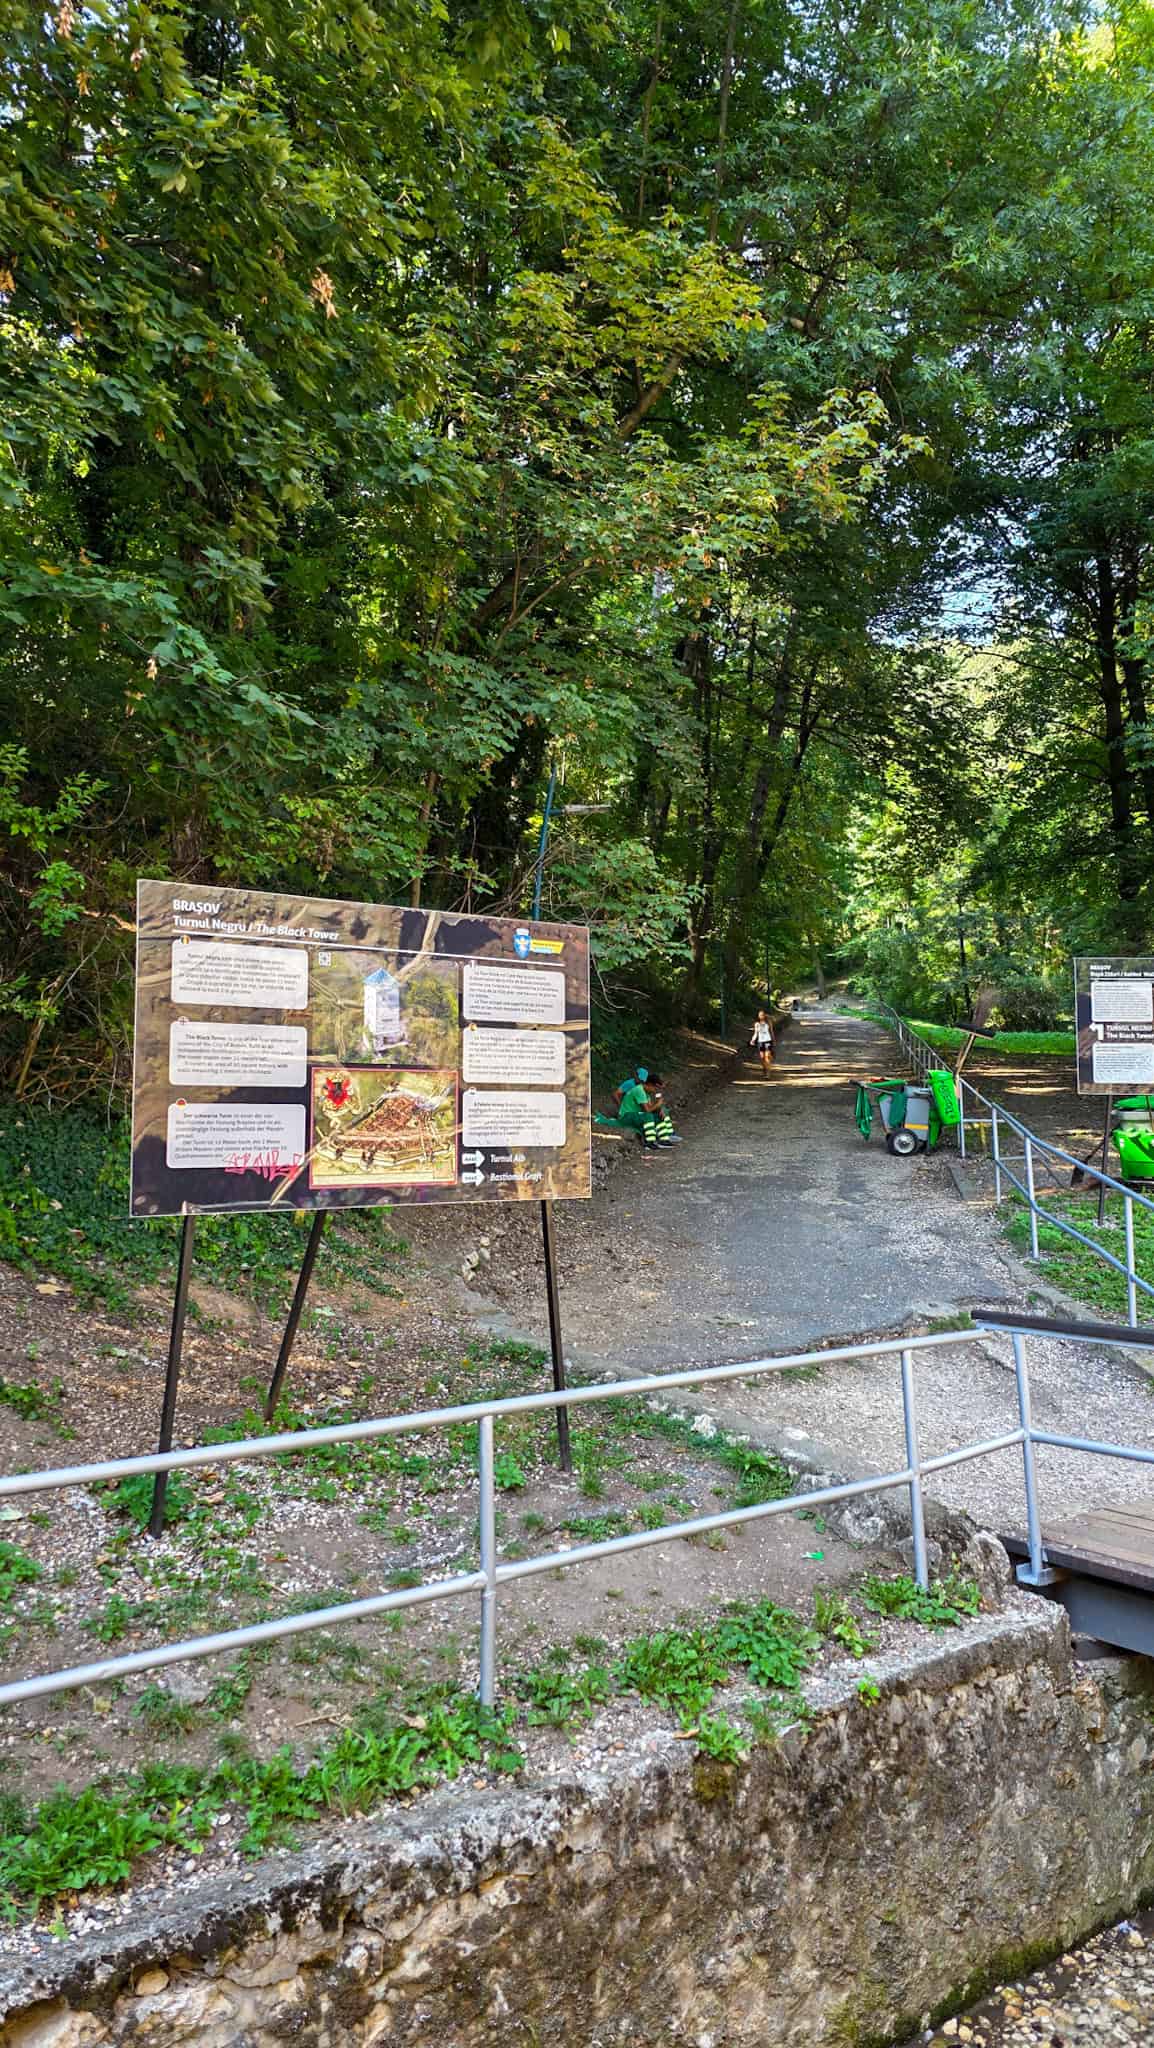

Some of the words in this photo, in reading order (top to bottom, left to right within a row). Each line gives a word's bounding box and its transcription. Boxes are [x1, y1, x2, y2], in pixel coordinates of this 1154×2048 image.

[173, 915, 210, 930] Turnul
[213, 918, 246, 934] Negru
[256, 923, 275, 935] The
[278, 925, 306, 938] Black
[308, 928, 338, 940] Tower
